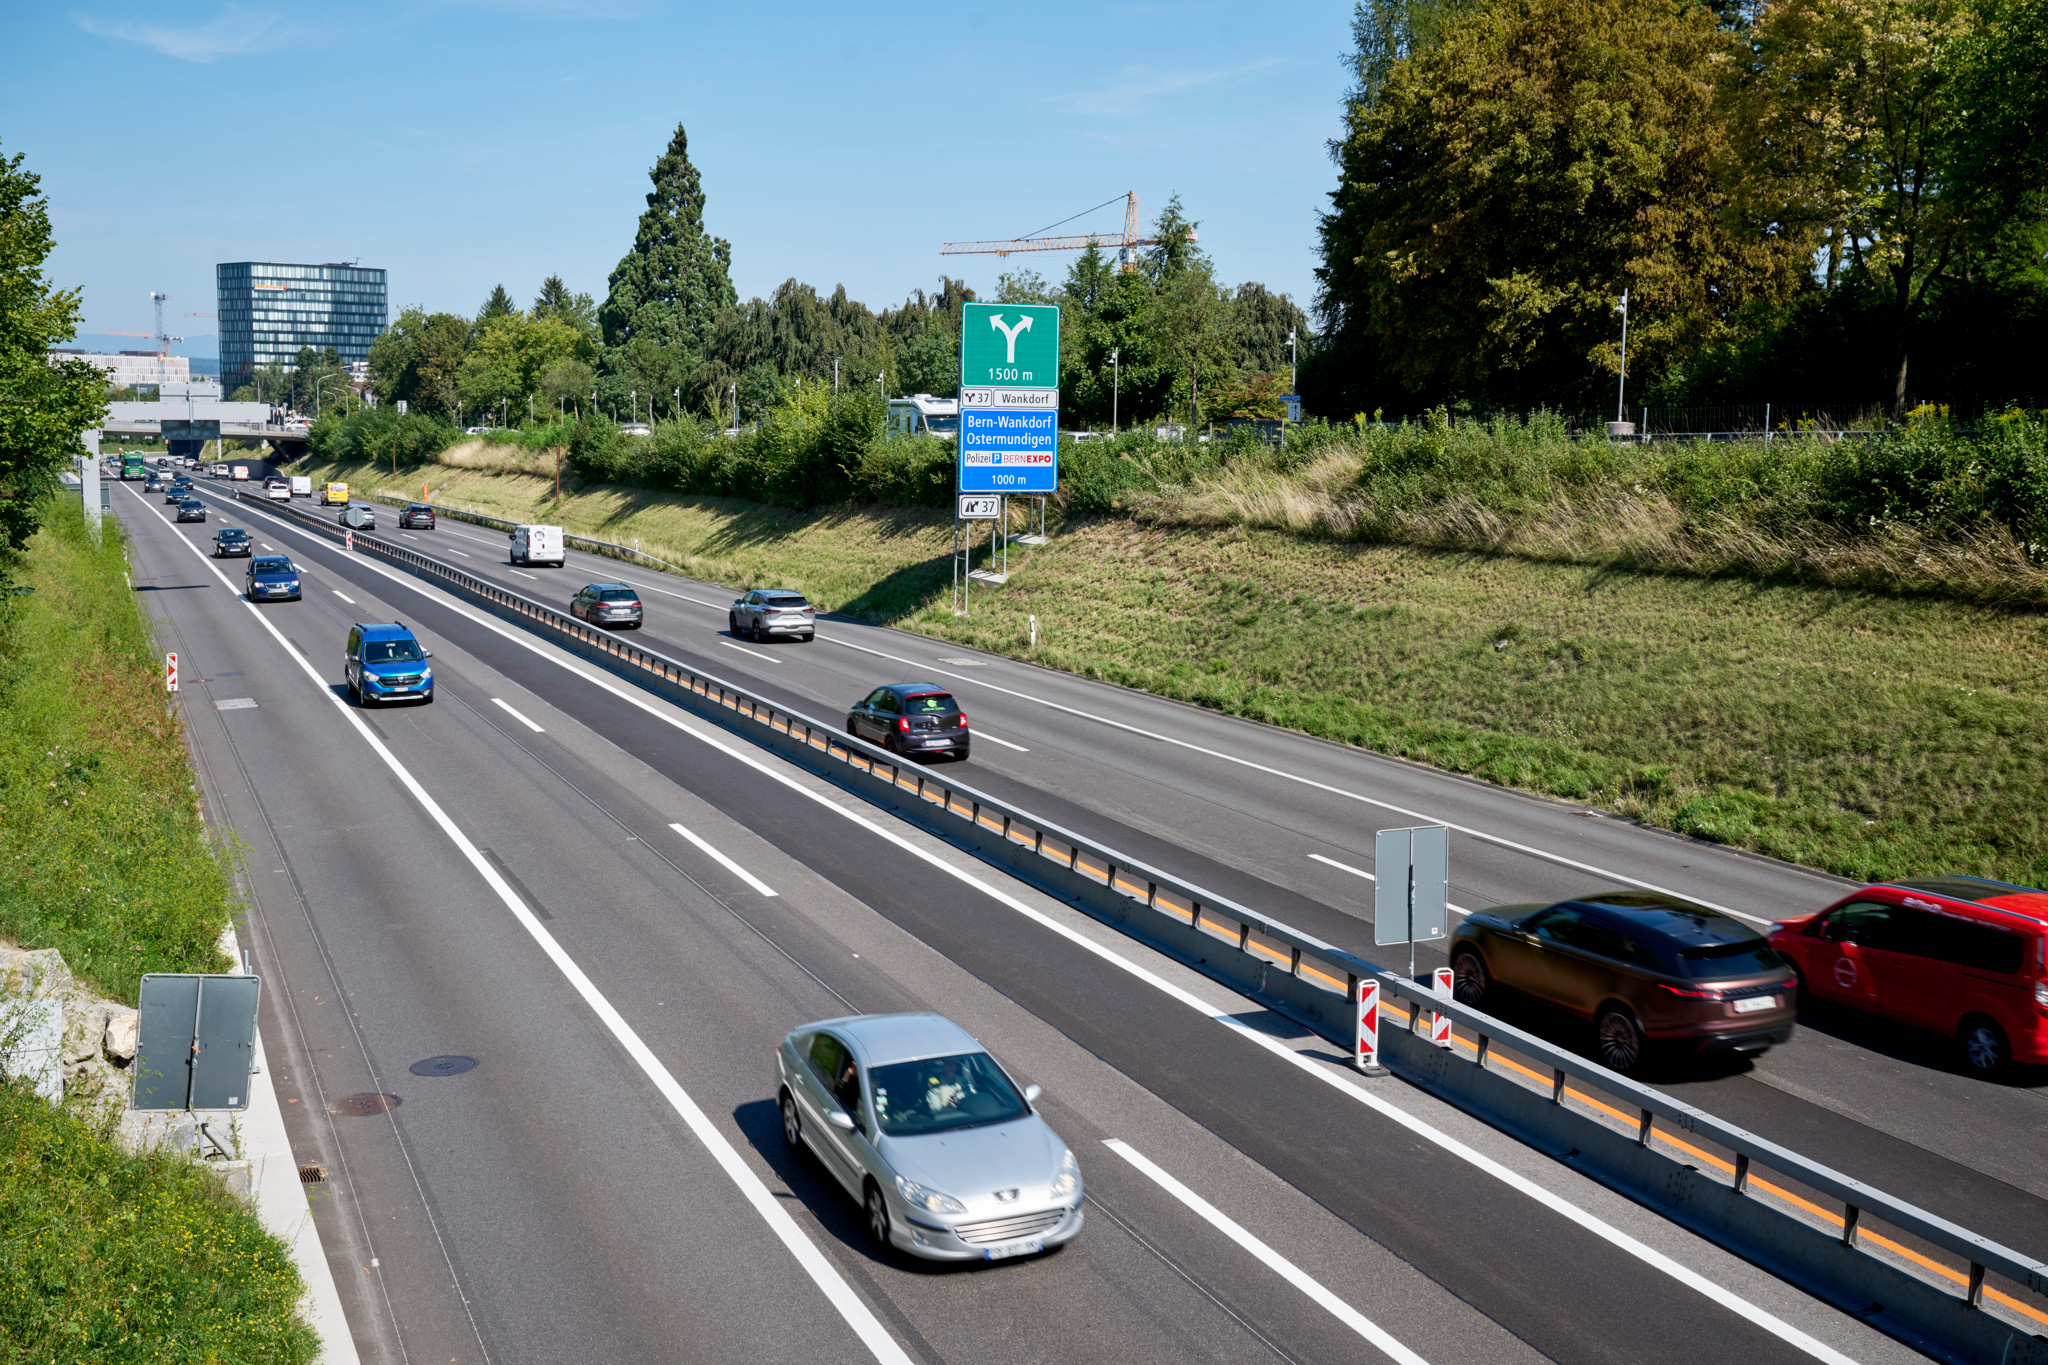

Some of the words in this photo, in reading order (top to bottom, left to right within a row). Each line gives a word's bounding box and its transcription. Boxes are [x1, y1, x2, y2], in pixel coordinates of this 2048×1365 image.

[988, 368, 1018, 380] 1500
[1022, 371, 1033, 380] m
[977, 393, 989, 402] 37
[1001, 393, 1050, 404] Wankdorf
[967, 415, 1052, 428] Bern-Wankdorf
[966, 432, 1052, 448] Ostermundigen
[966, 453, 991, 463] Polizei
[993, 454, 1001, 463] P
[1003, 454, 1051, 463] BERNEXPO
[991, 474, 1015, 485] 1000
[1017, 476, 1026, 485] m
[981, 500, 995, 513] 37
